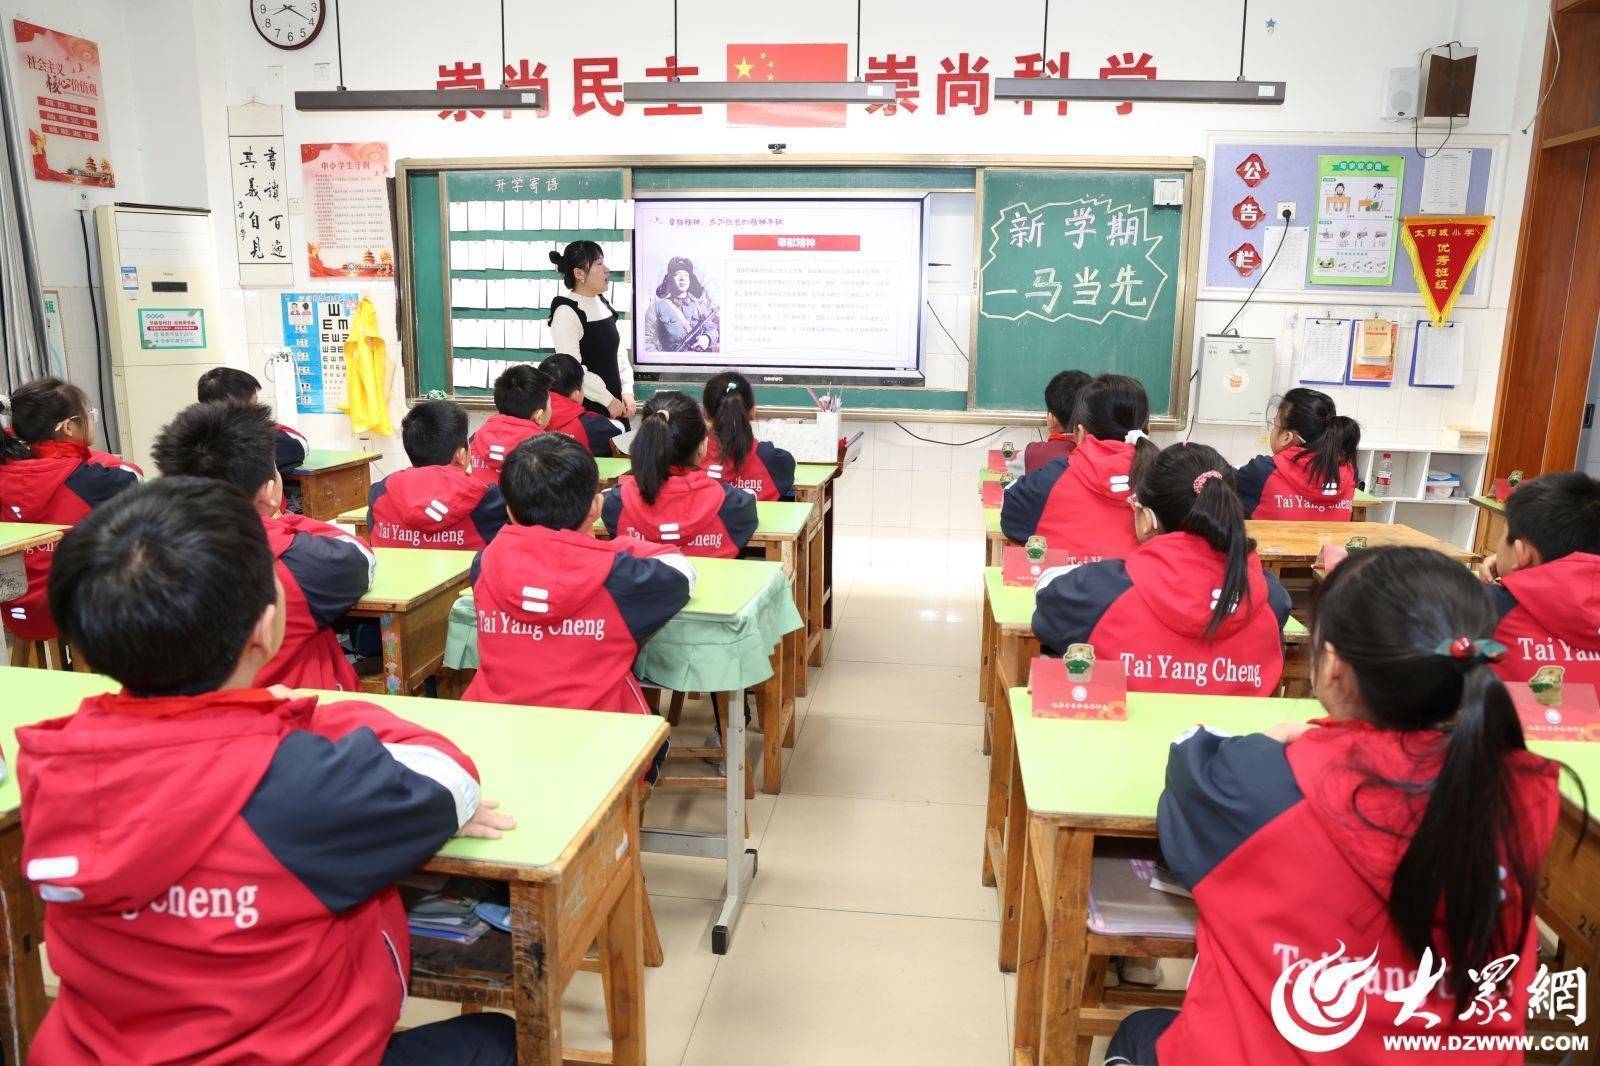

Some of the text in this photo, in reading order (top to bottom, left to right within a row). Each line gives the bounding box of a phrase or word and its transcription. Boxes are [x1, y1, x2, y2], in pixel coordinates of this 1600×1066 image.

[311, 3, 317, 12] 3
[265, 18, 271, 28] 8
[275, 29, 281, 38] 7
[300, 28, 306, 38] 5
[287, 32, 293, 41] 6
[27, 54, 65, 76] 社会主义
[46, 74, 98, 96] 核心价值观
[321, 161, 371, 170] 中小学生守则
[495, 177, 560, 194] 开学寄语
[1235, 161, 1261, 269] 公告栏
[1009, 206, 1140, 250] 新学期
[1414, 228, 1475, 238] 太阳城小学
[1434, 243, 1451, 290] 优秀班级
[985, 264, 1146, 314] 一马当先
[1275, 494, 1293, 508] Tai
[378, 521, 390, 538] Tai
[391, 524, 420, 546] Yang
[478, 610, 496, 633] Tai
[1516, 637, 1556, 661] Tai
[1120, 652, 1262, 688] Tai Yang Cheng
